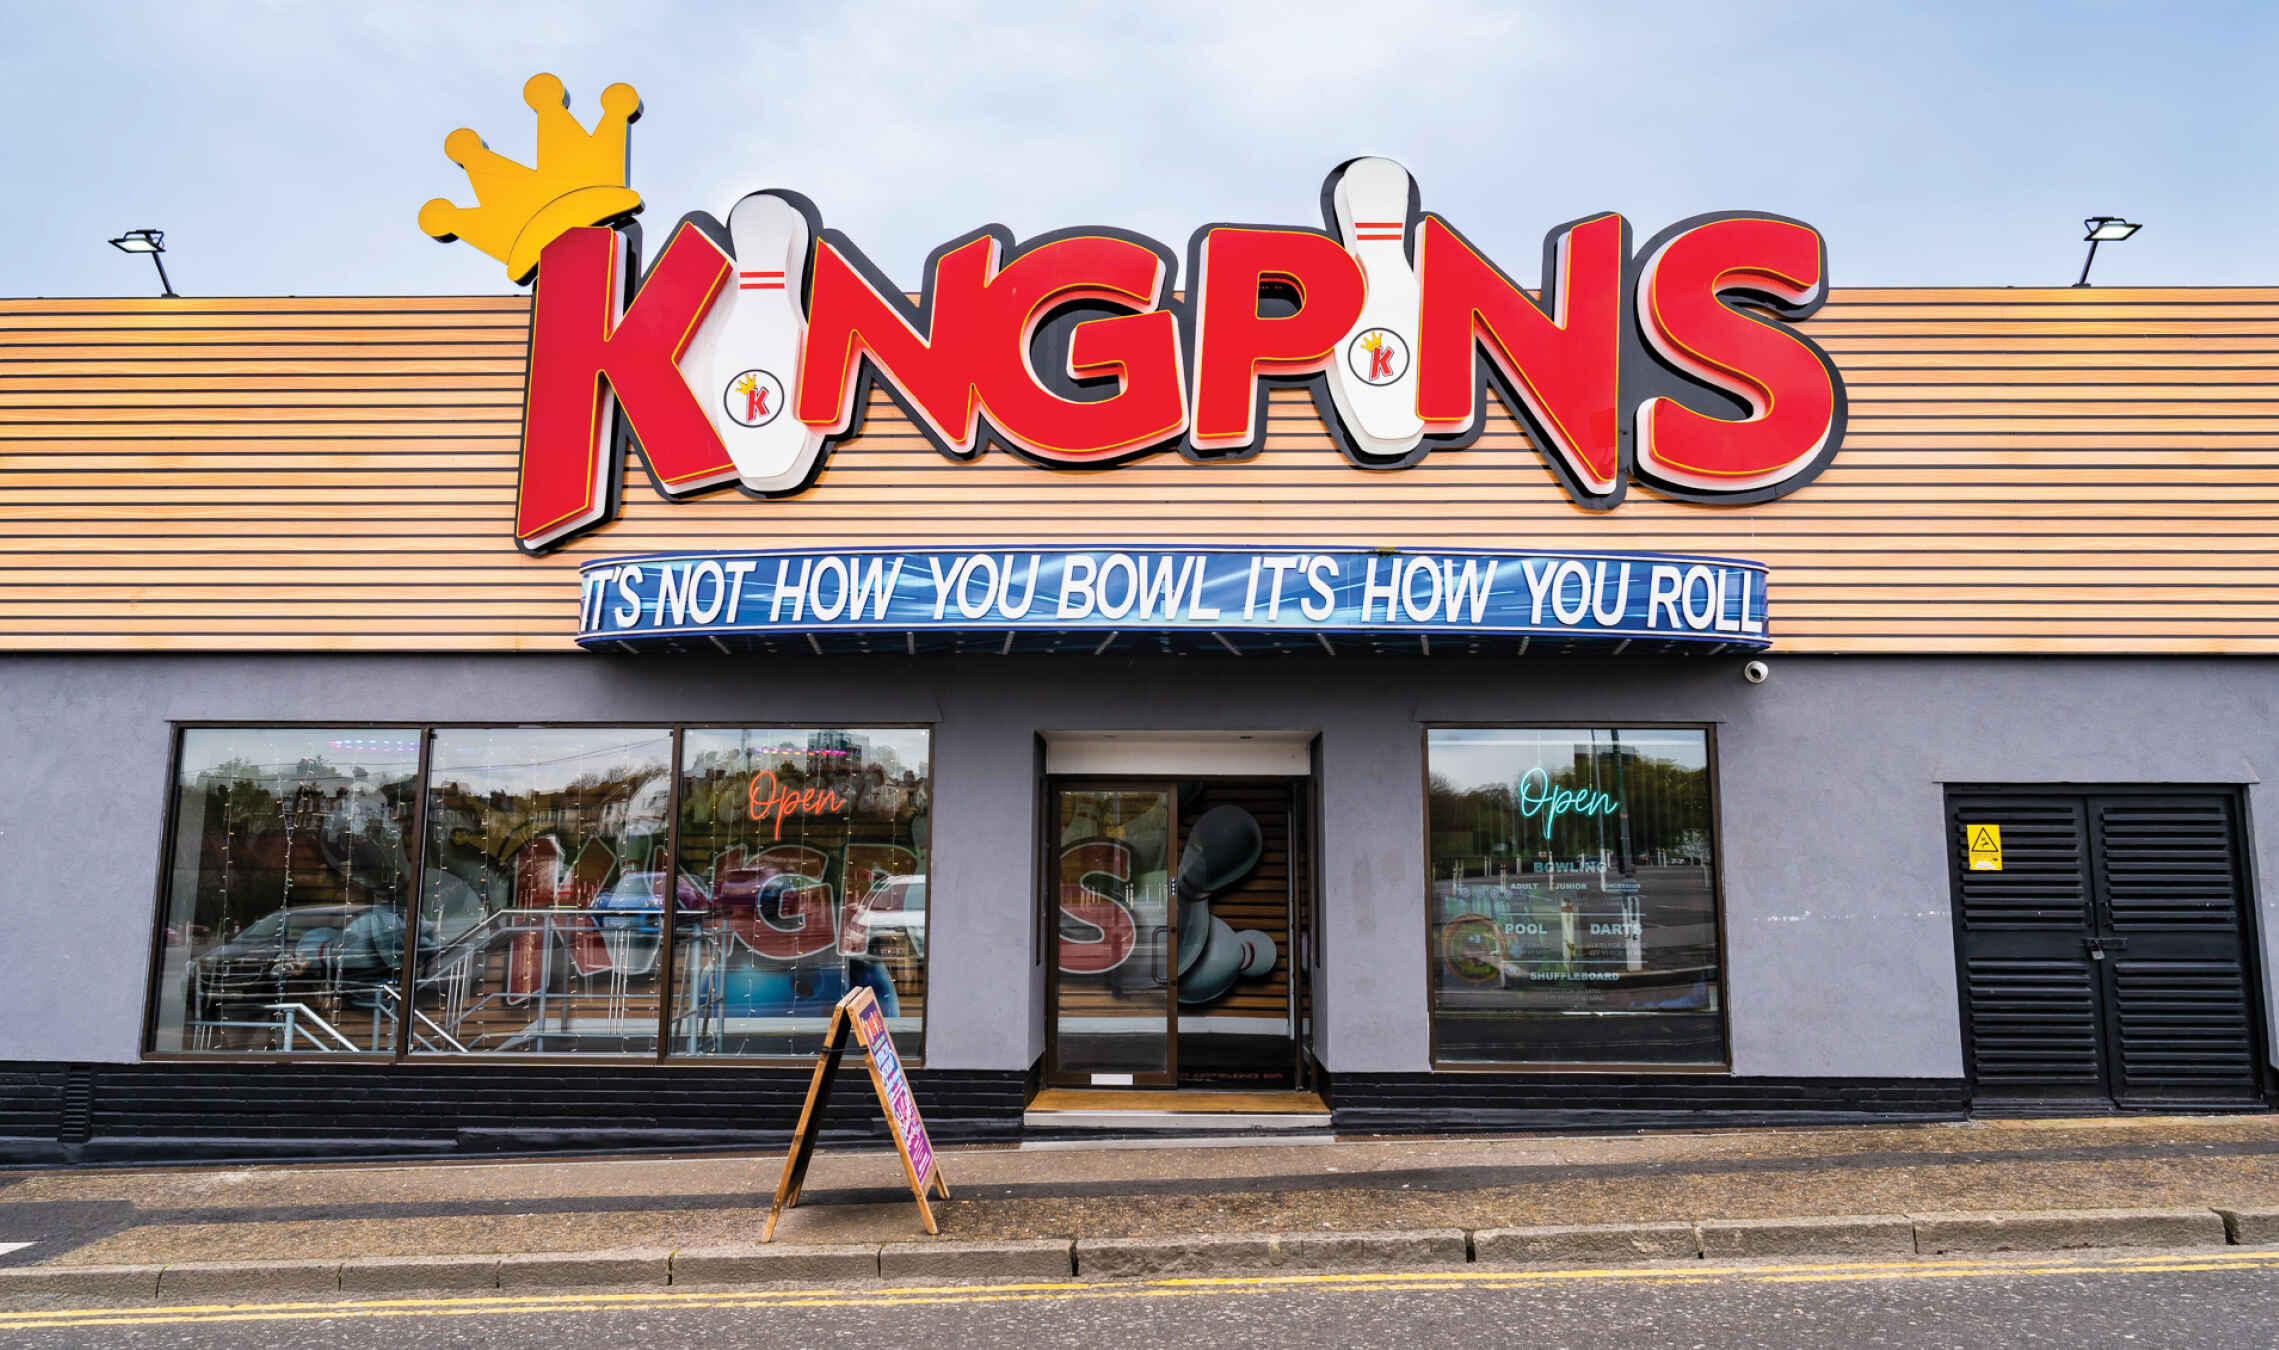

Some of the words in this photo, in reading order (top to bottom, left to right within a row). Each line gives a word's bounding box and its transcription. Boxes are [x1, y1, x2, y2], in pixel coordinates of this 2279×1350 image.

[580, 565, 644, 632] IT'S
[653, 560, 757, 626] NOT
[769, 555, 905, 622] HOW
[928, 554, 1041, 620] YOU
[1056, 554, 1221, 621] BOWL
[1243, 555, 1340, 622] IT'S
[1361, 556, 1499, 624] HOW
[1521, 560, 1631, 627] YOU
[1647, 565, 1763, 634] ROLL
[749, 769, 845, 841] Open
[1519, 767, 1619, 840] Open
[1510, 882, 1539, 890] ADULT
[1533, 861, 1608, 873] BOWLING
[1504, 922, 1549, 935] POOL
[1590, 922, 1643, 935] DARTS
